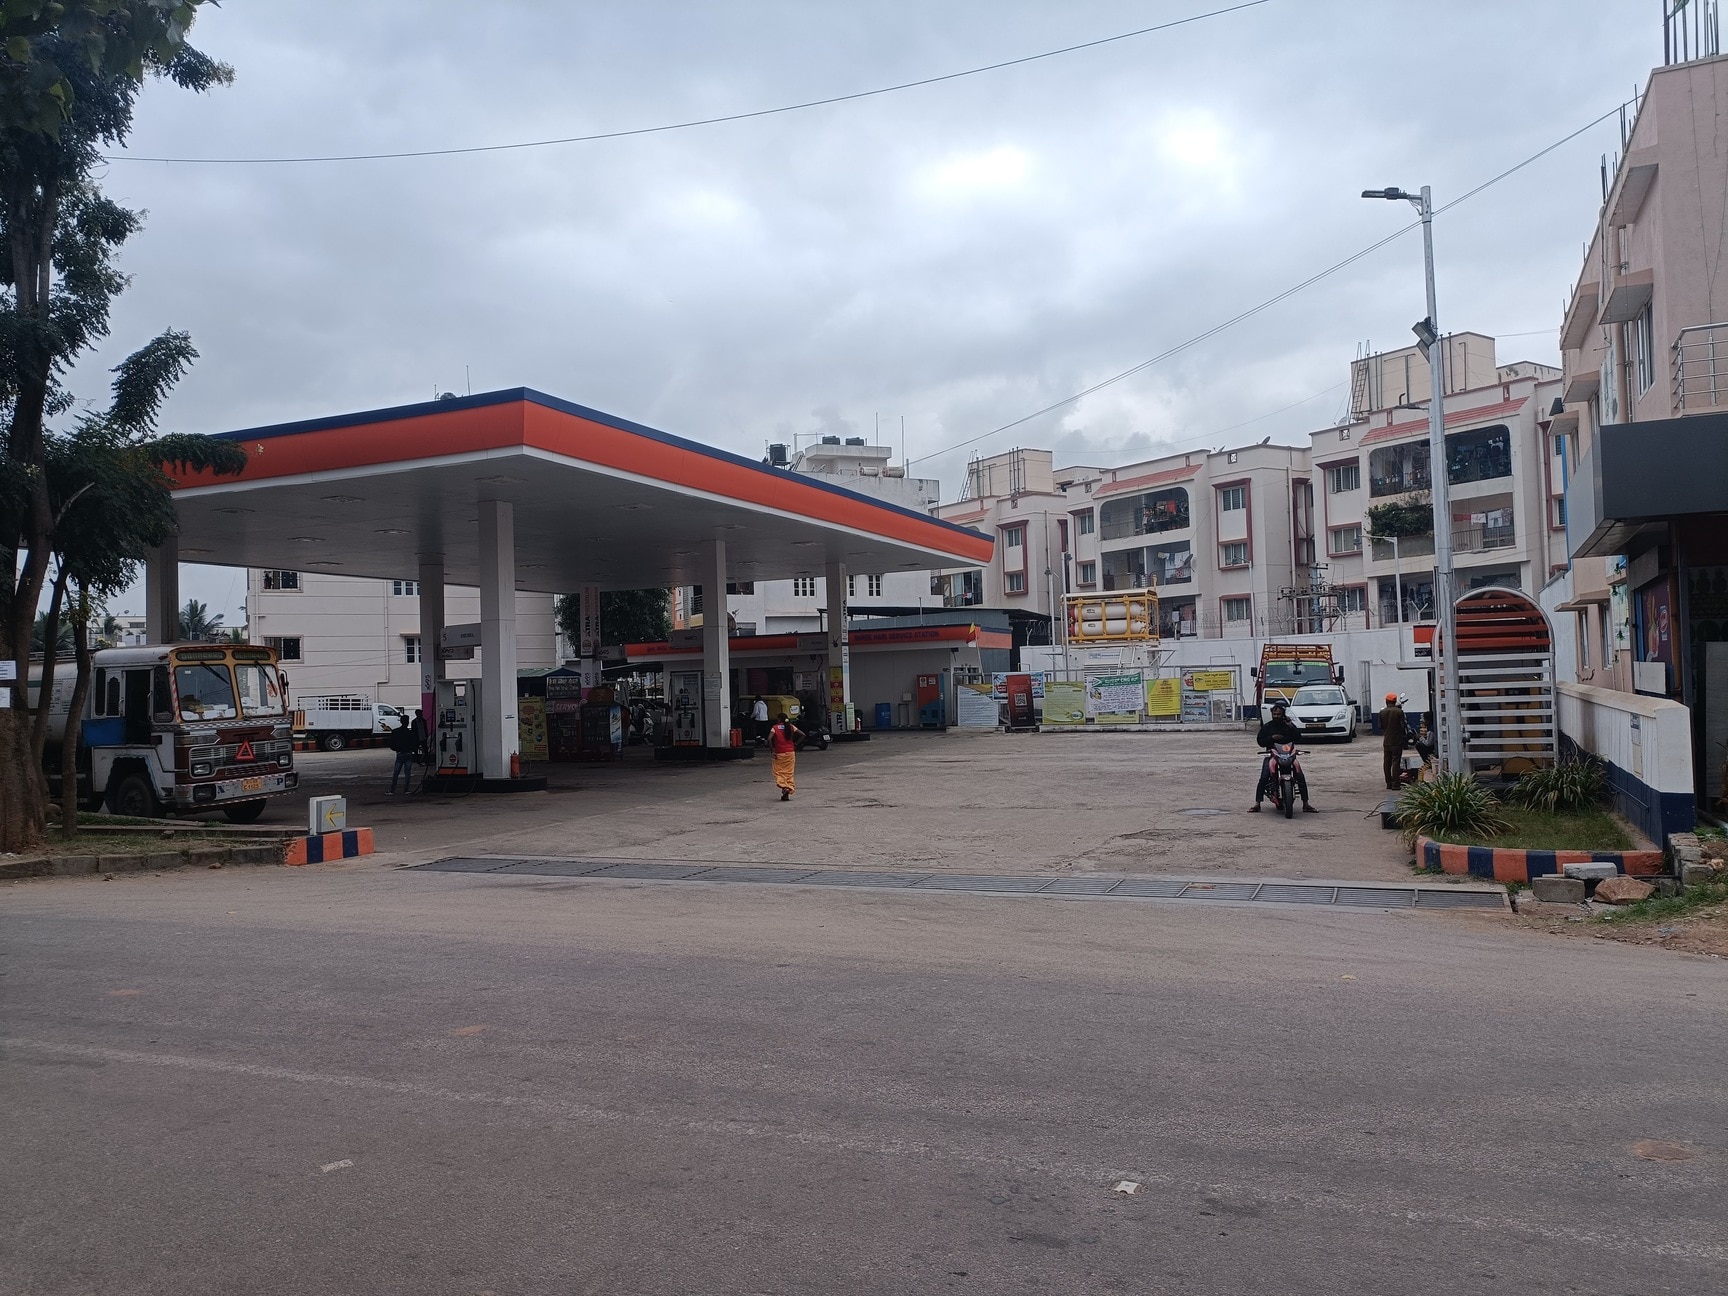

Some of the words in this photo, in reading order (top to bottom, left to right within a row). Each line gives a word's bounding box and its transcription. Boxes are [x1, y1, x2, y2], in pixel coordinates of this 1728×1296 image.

[442, 633, 447, 641] 5
[890, 632, 912, 640] SERVICE
[914, 631, 939, 639] STATION
[555, 703, 577, 711] SERVO
[276, 778, 284, 786] P
